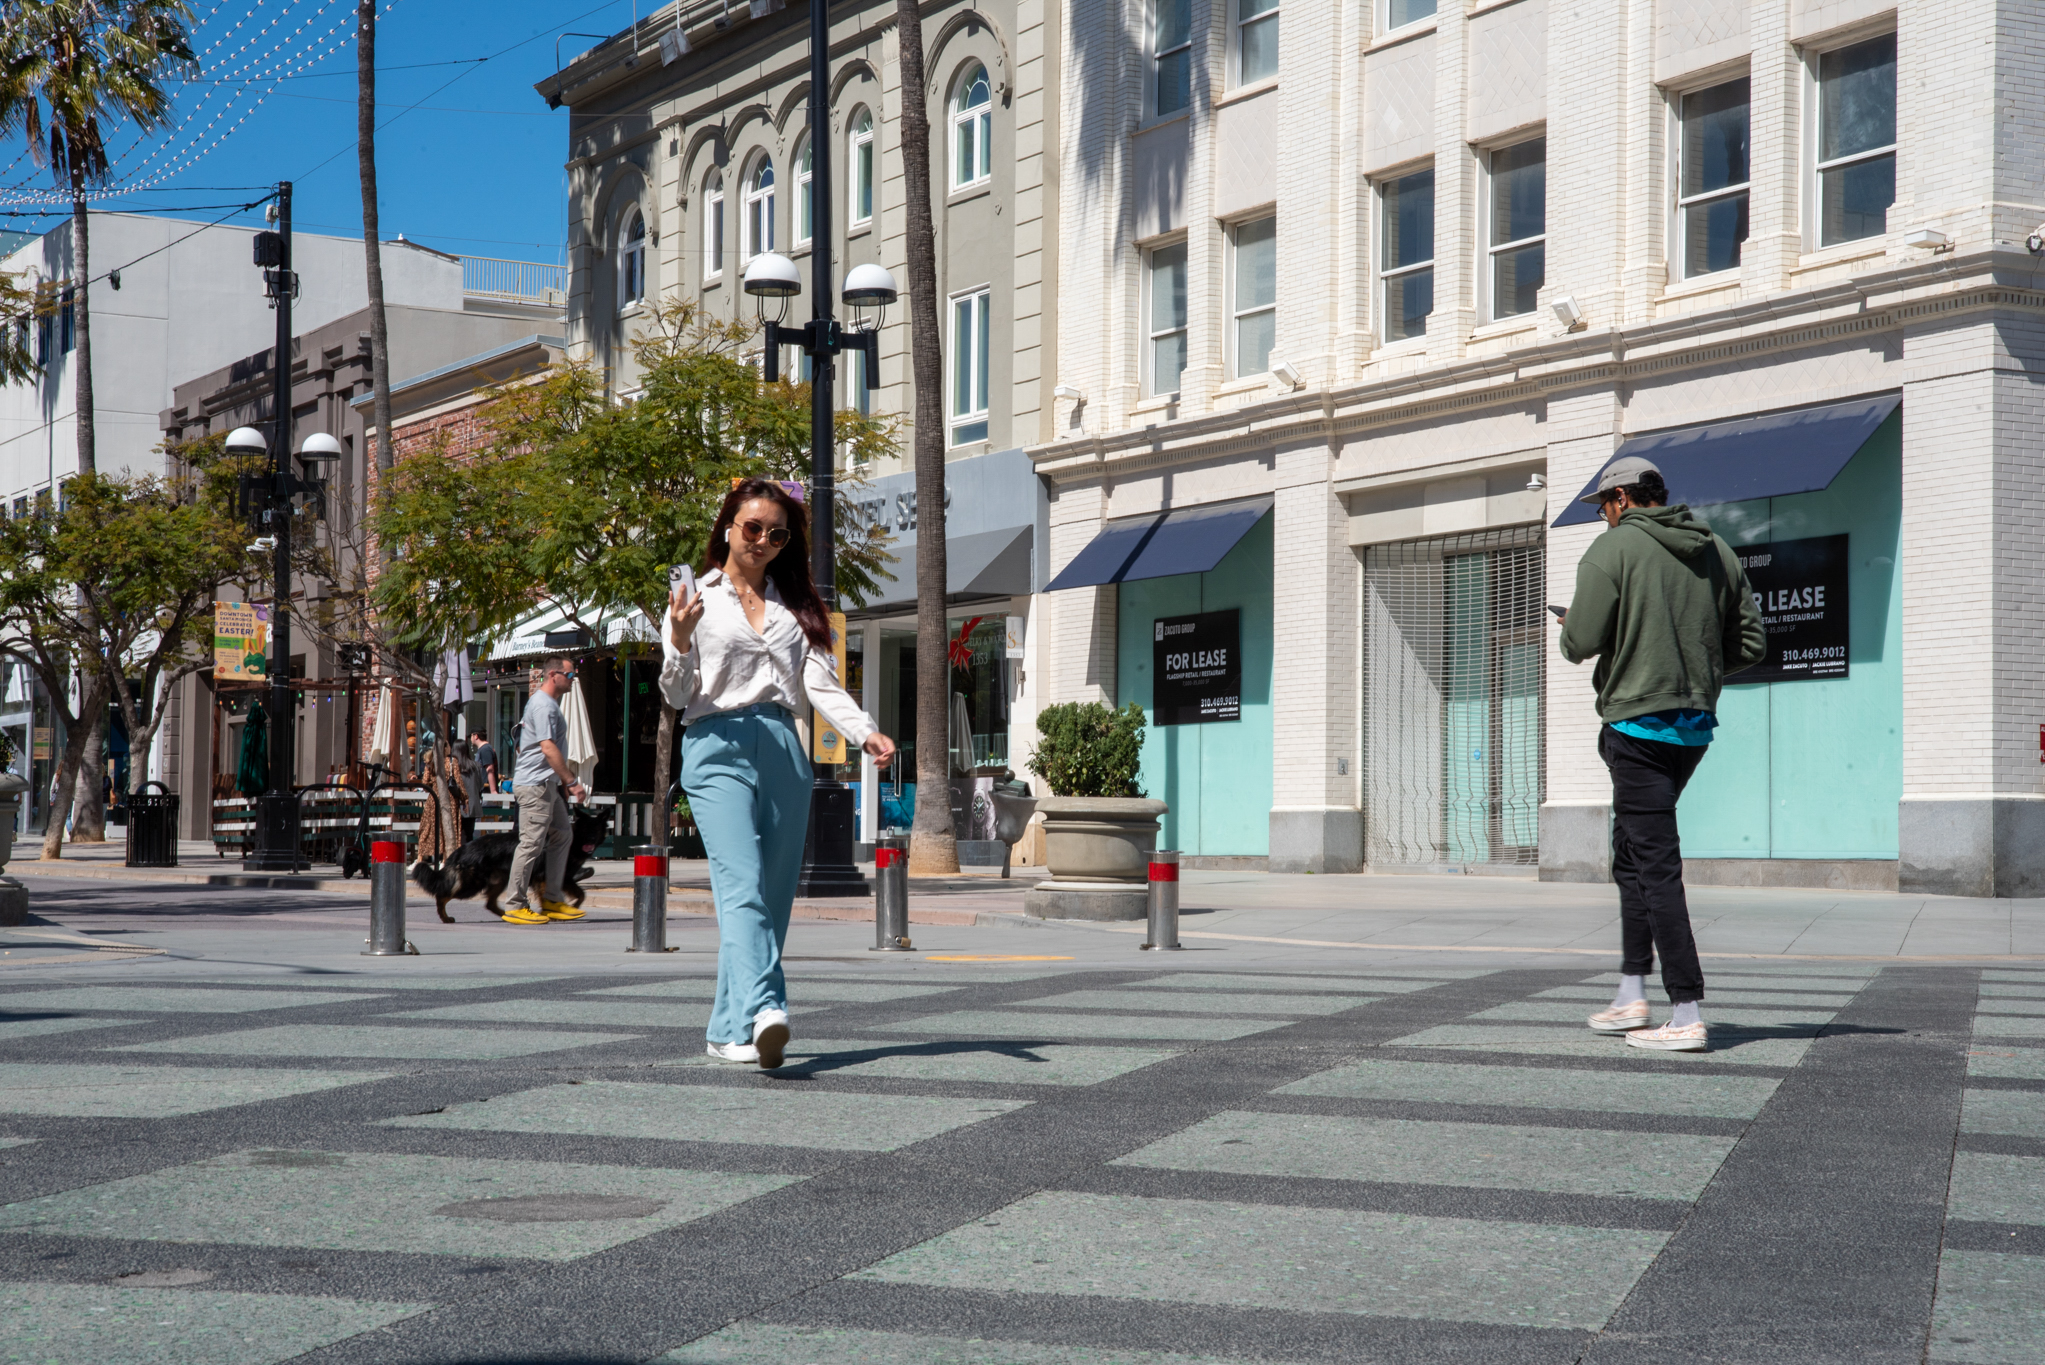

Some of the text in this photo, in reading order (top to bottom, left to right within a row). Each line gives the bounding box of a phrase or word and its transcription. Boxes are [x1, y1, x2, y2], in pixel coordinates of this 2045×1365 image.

[1749, 554, 1772, 568] GROUP
[1768, 586, 1825, 612] LEASE
[1761, 616, 1777, 624] ETAIL
[1783, 612, 1824, 622] RESTAURANT
[219, 627, 254, 636] EASTER!
[1164, 623, 1195, 636] ZACUTO GROUP
[1764, 626, 1788, 634] 0-35,000
[512, 640, 531, 651] Barney's
[972, 652, 988, 666] 1353
[1166, 648, 1227, 671] FOR LEASE
[1782, 646, 1845, 661] 310.469.9012
[1202, 669, 1226, 677] RESTAURANT
[1200, 696, 1238, 707] 310.469.9012
